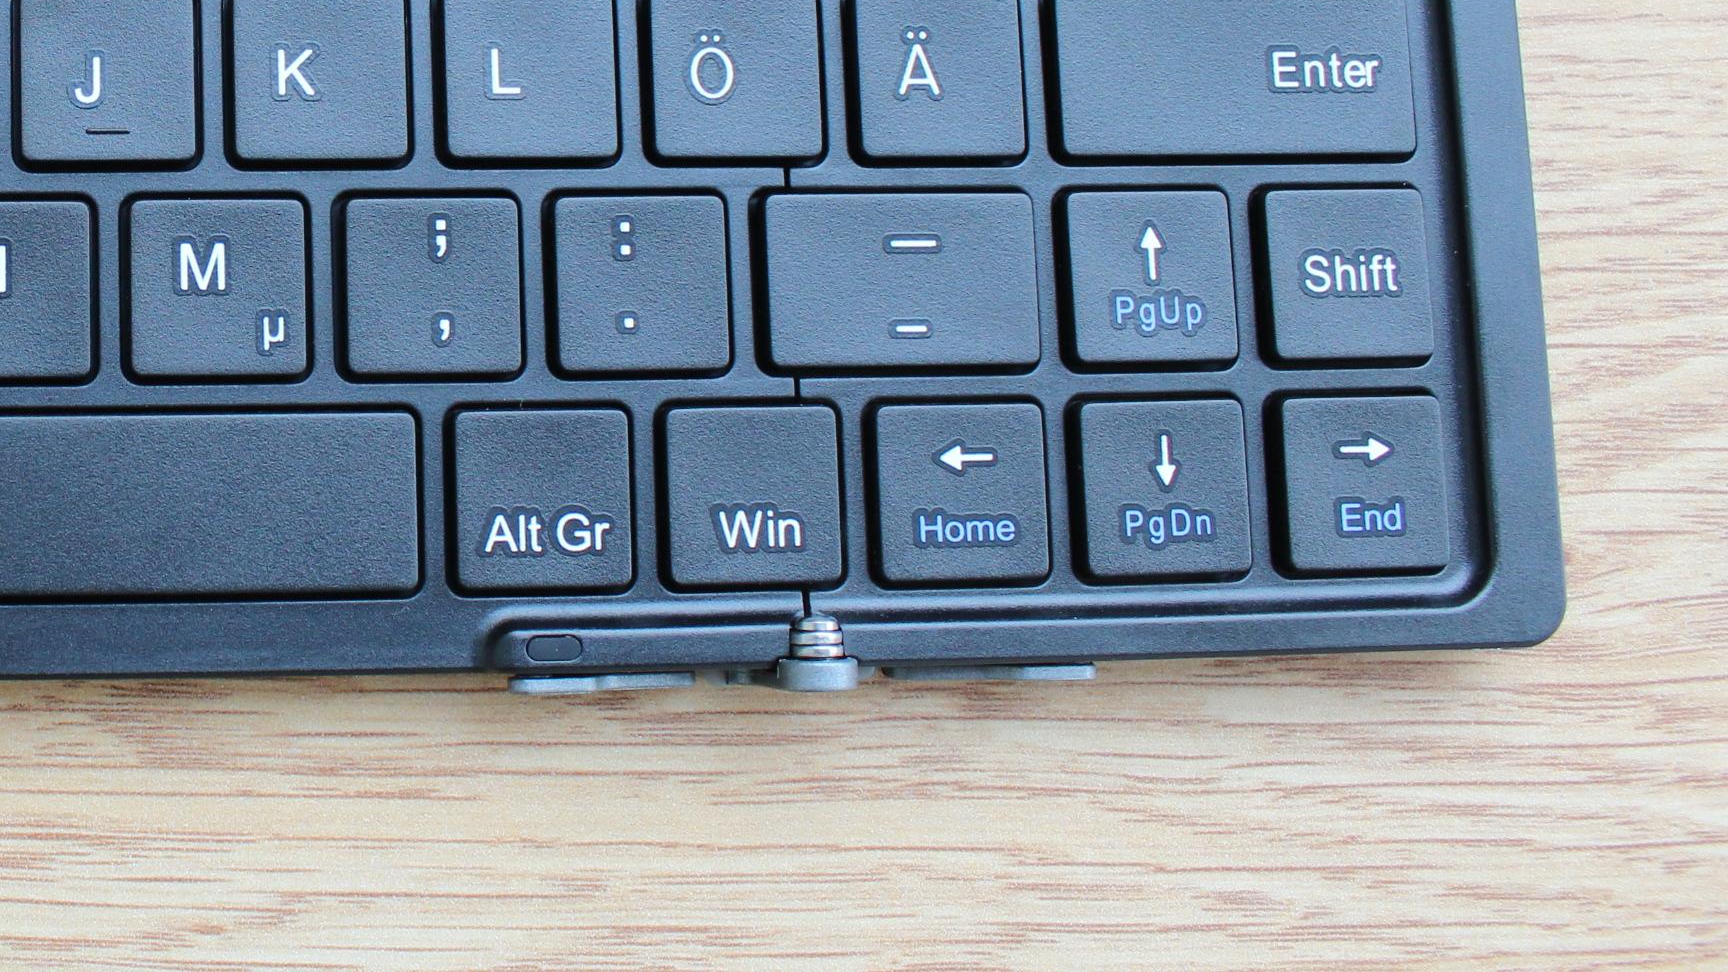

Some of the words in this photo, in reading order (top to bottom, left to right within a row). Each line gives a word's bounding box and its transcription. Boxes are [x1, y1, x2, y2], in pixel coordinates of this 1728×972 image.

[74, 56, 101, 104] J
[277, 49, 315, 96] K
[490, 48, 521, 95] L
[690, 34, 734, 99] Ö
[898, 31, 940, 96] Ä
[1272, 51, 1379, 88] Enter
[179, 242, 226, 291] M
[1304, 254, 1398, 293] Shift
[1115, 296, 1202, 332] PgUp
[484, 514, 543, 553] Alt
[556, 512, 610, 552] Gr
[719, 509, 801, 548] Win
[919, 516, 1015, 544] Home
[1125, 510, 1212, 545] PgDn
[1341, 503, 1403, 532] End
